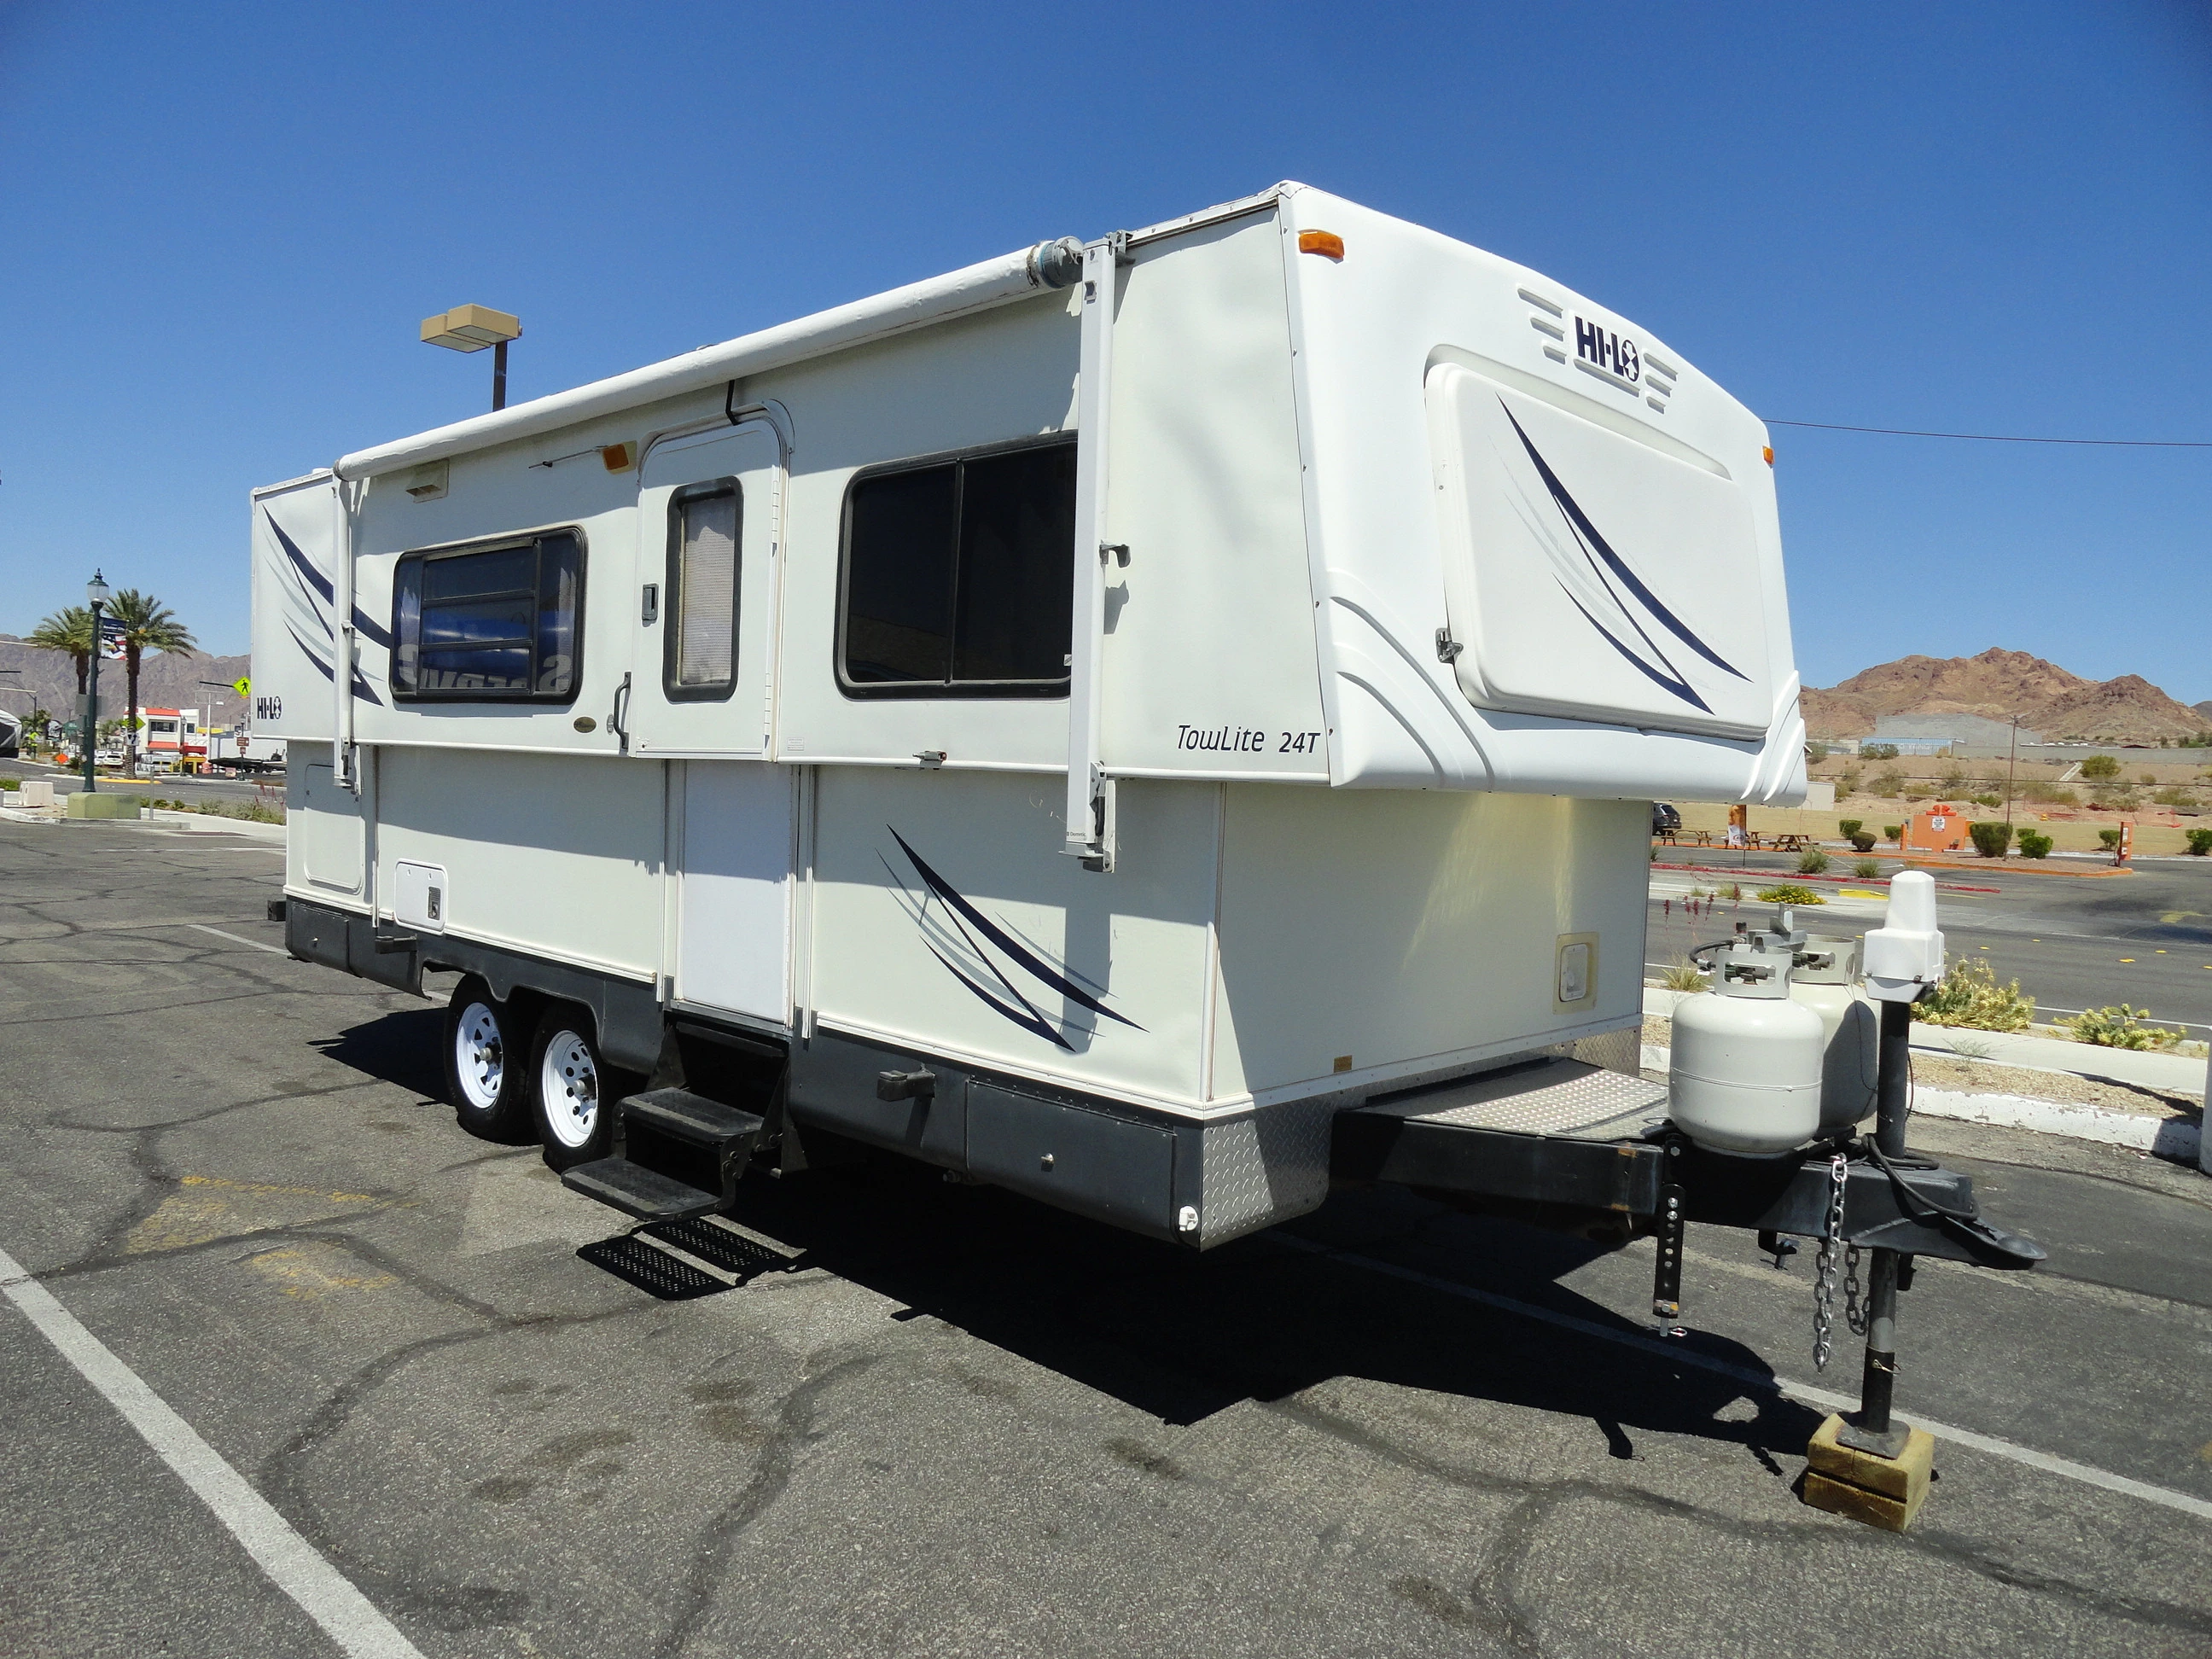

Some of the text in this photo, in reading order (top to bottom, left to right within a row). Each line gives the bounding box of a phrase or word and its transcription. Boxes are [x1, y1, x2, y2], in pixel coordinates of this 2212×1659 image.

[1575, 315, 1639, 382] HI-LO
[257, 696, 282, 719] HI-LO
[1178, 725, 1321, 754] TowLite 24T
